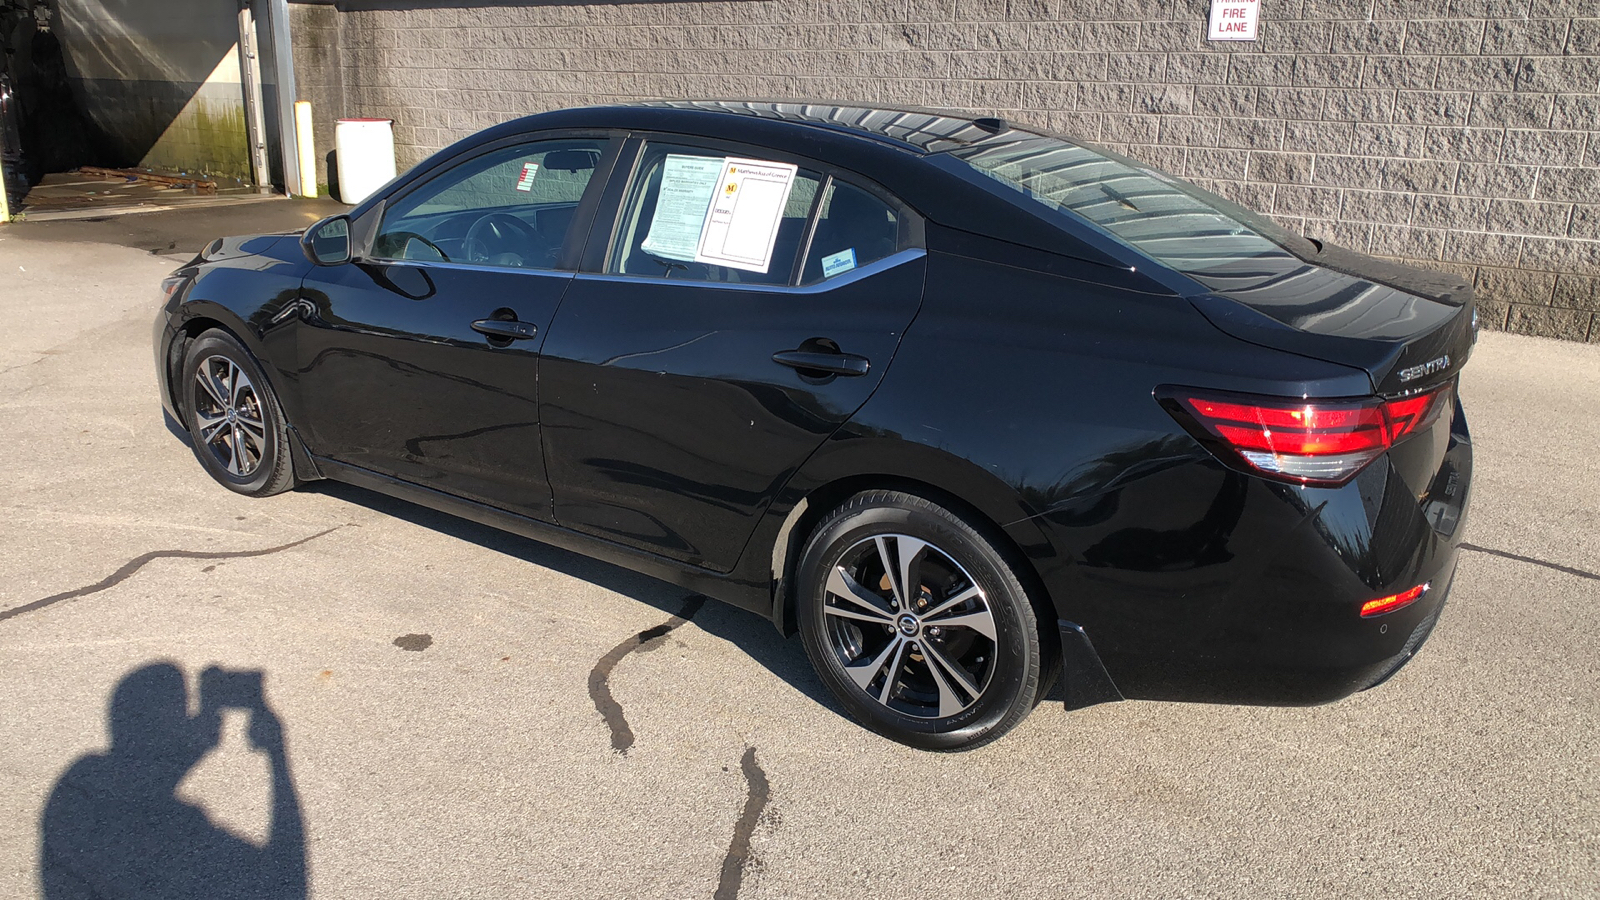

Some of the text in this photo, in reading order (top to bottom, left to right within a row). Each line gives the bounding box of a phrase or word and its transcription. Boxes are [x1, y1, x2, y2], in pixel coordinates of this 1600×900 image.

[1222, 8, 1247, 19] FIRE
[1218, 22, 1248, 32] LANE
[1399, 354, 1451, 383] SENTRA
